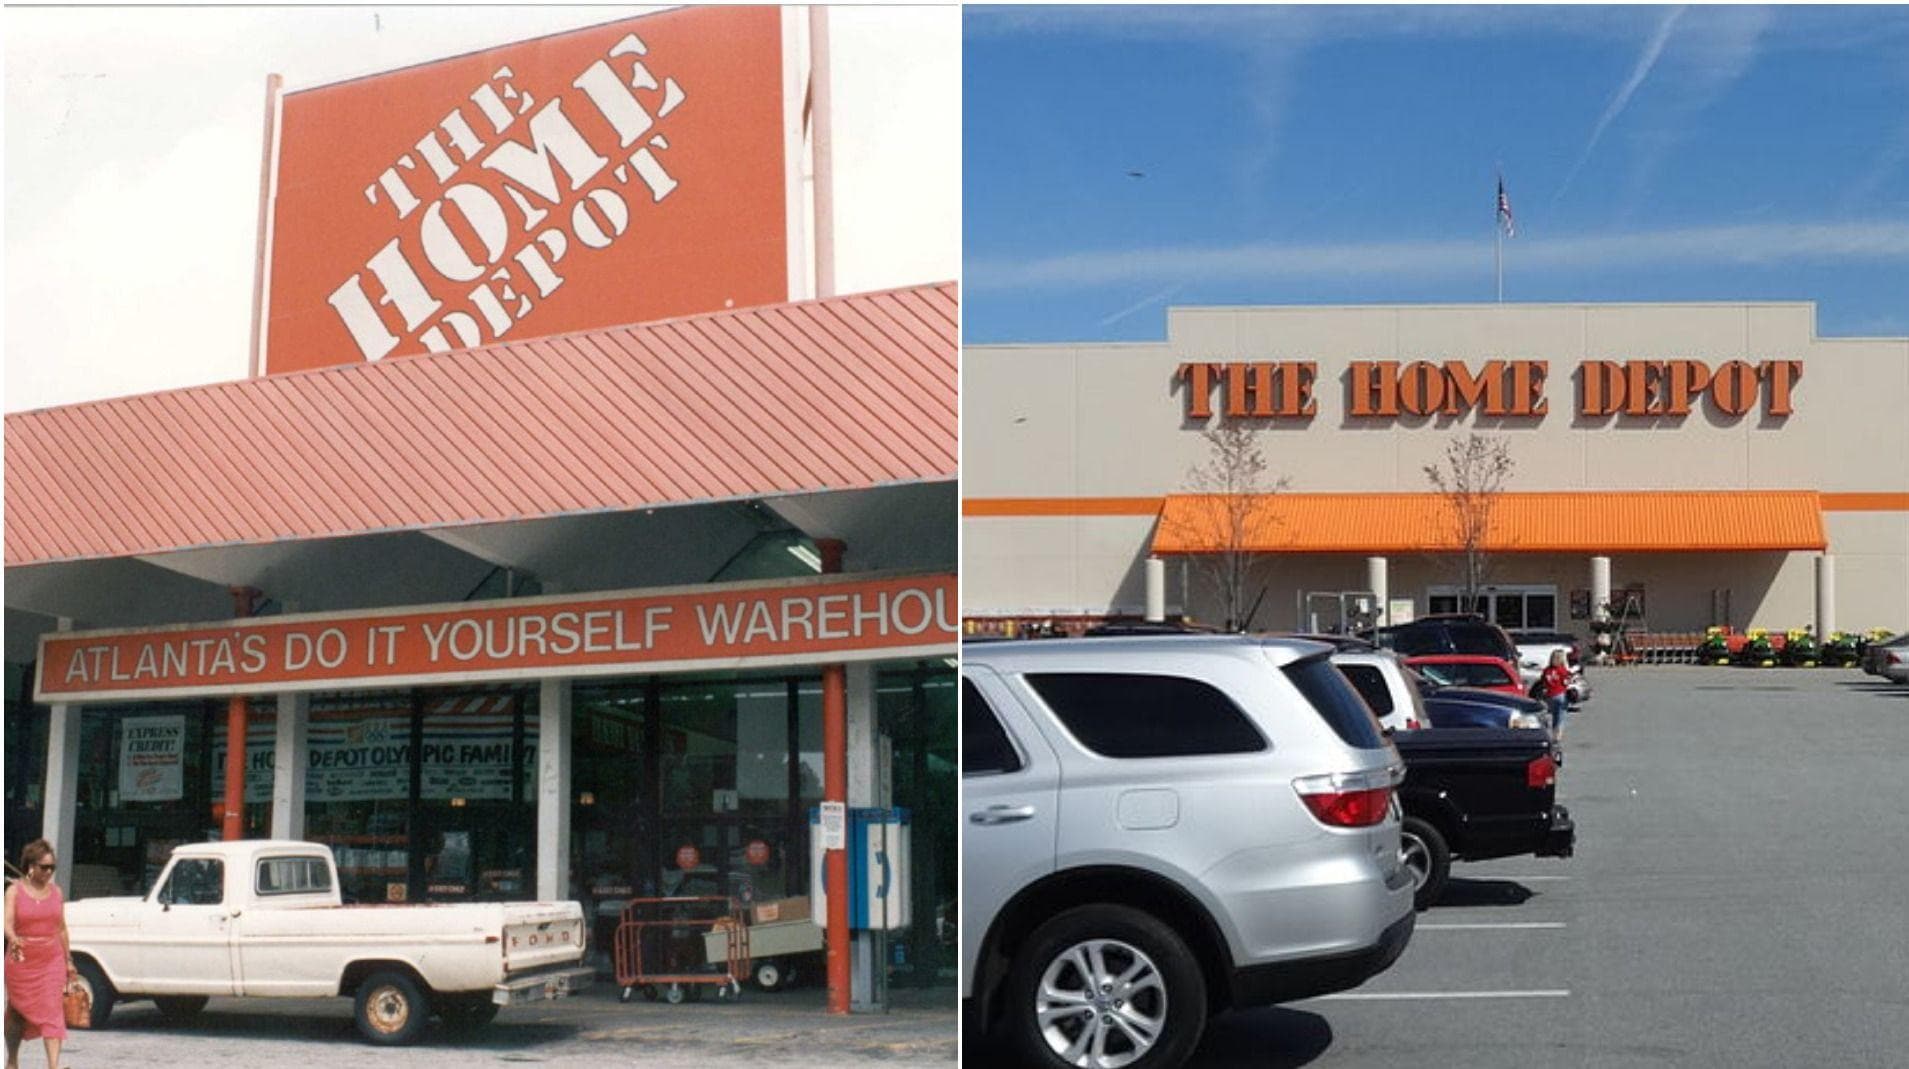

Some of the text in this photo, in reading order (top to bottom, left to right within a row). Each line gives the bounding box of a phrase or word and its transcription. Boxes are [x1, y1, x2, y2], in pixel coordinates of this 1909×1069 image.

[327, 32, 687, 363] HOME
[362, 64, 535, 220] THE
[419, 133, 680, 356] DEPOT
[1179, 359, 1804, 417] THE HOME DEPOT
[64, 631, 267, 684] ATLANTA'S
[284, 627, 348, 672] DO
[366, 625, 406, 666] IT
[421, 605, 674, 662] YOURSELF
[309, 746, 369, 768] DEPOT
